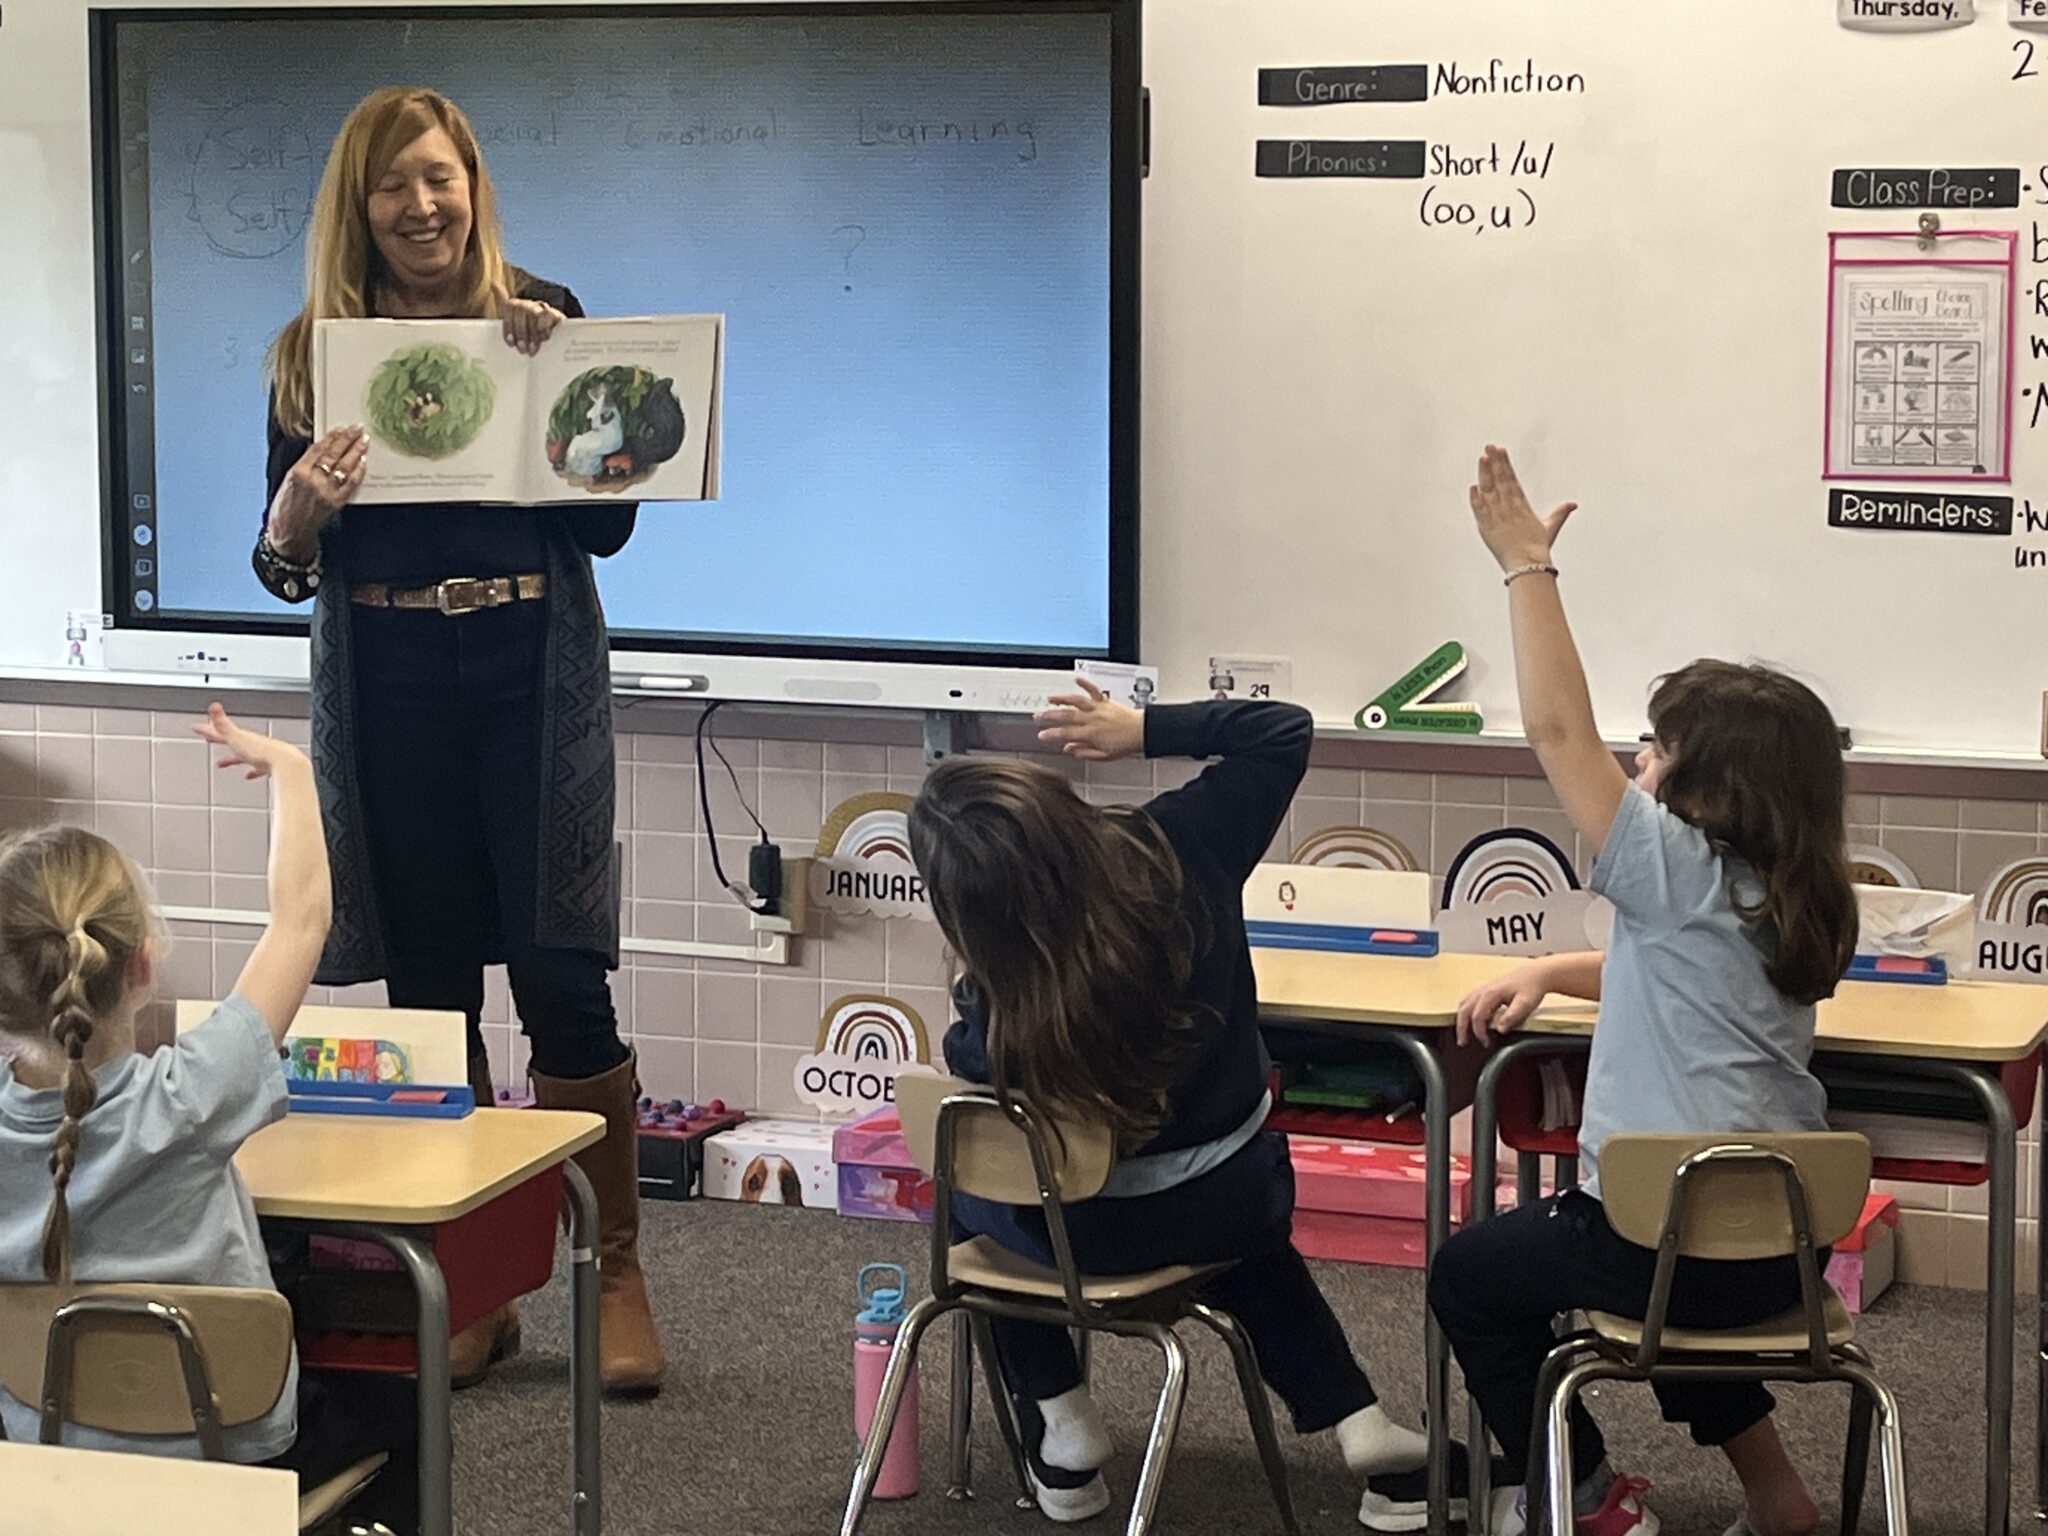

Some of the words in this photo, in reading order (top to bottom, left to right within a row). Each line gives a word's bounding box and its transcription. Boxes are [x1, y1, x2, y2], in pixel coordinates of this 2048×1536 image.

[2020, 0, 2048, 16] Fe
[1295, 70, 1378, 102] Genre:
[1433, 58, 1586, 96] Nonfiction
[858, 108, 1038, 162] Learning
[1286, 140, 1389, 175] Phonics:
[1429, 142, 1501, 178] Short
[1847, 170, 1920, 207] Class
[1927, 167, 1996, 208] Prep:
[1859, 289, 1929, 316] Spelling
[1839, 494, 1999, 528] Reminders:
[1250, 683, 1270, 698] 29
[826, 869, 926, 903] JANUAR
[1486, 911, 1545, 946] MAY
[1978, 939, 2048, 974] AUG
[803, 1066, 896, 1103] OCTOB
